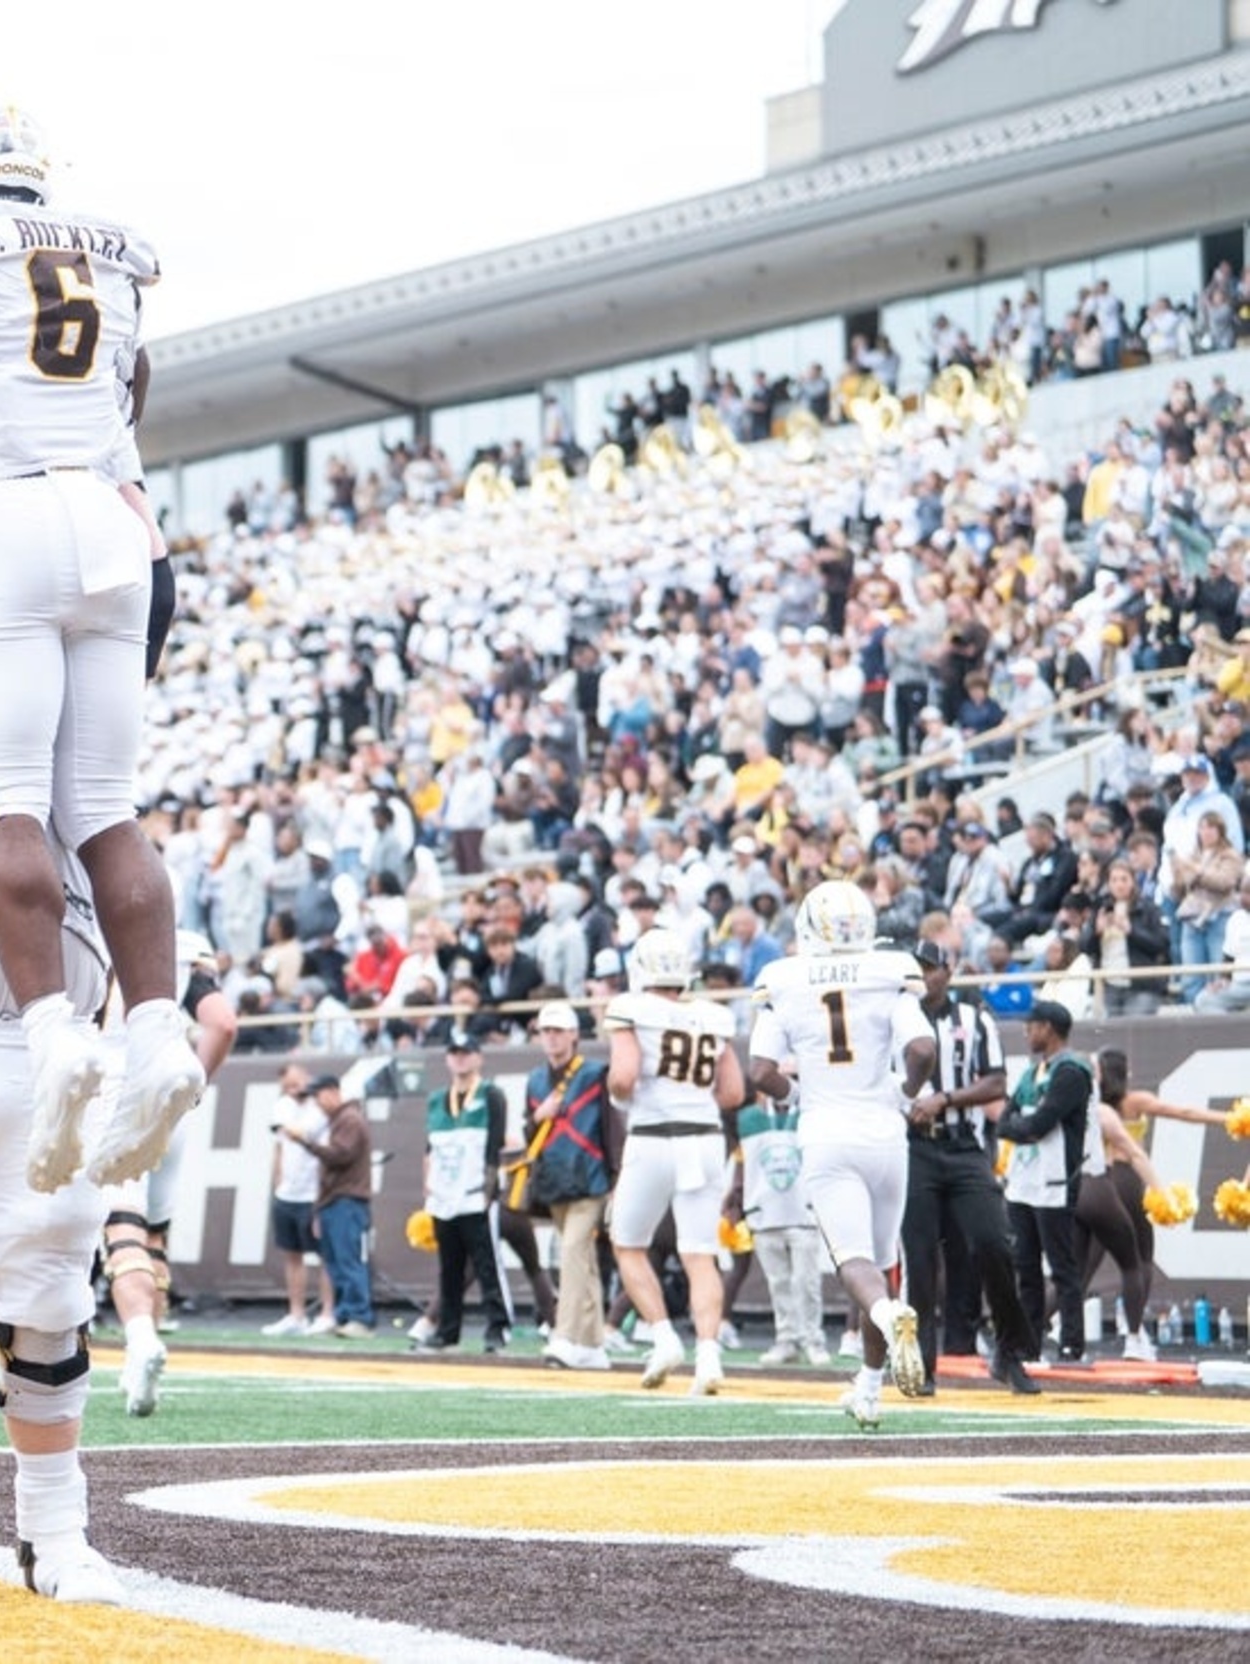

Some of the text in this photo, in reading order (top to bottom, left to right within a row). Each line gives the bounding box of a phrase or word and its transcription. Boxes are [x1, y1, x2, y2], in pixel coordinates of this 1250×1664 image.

[25, 249, 100, 382] 6
[808, 963, 860, 985] LEARY
[657, 1029, 717, 1088] 86
[820, 989, 854, 1065] 1
